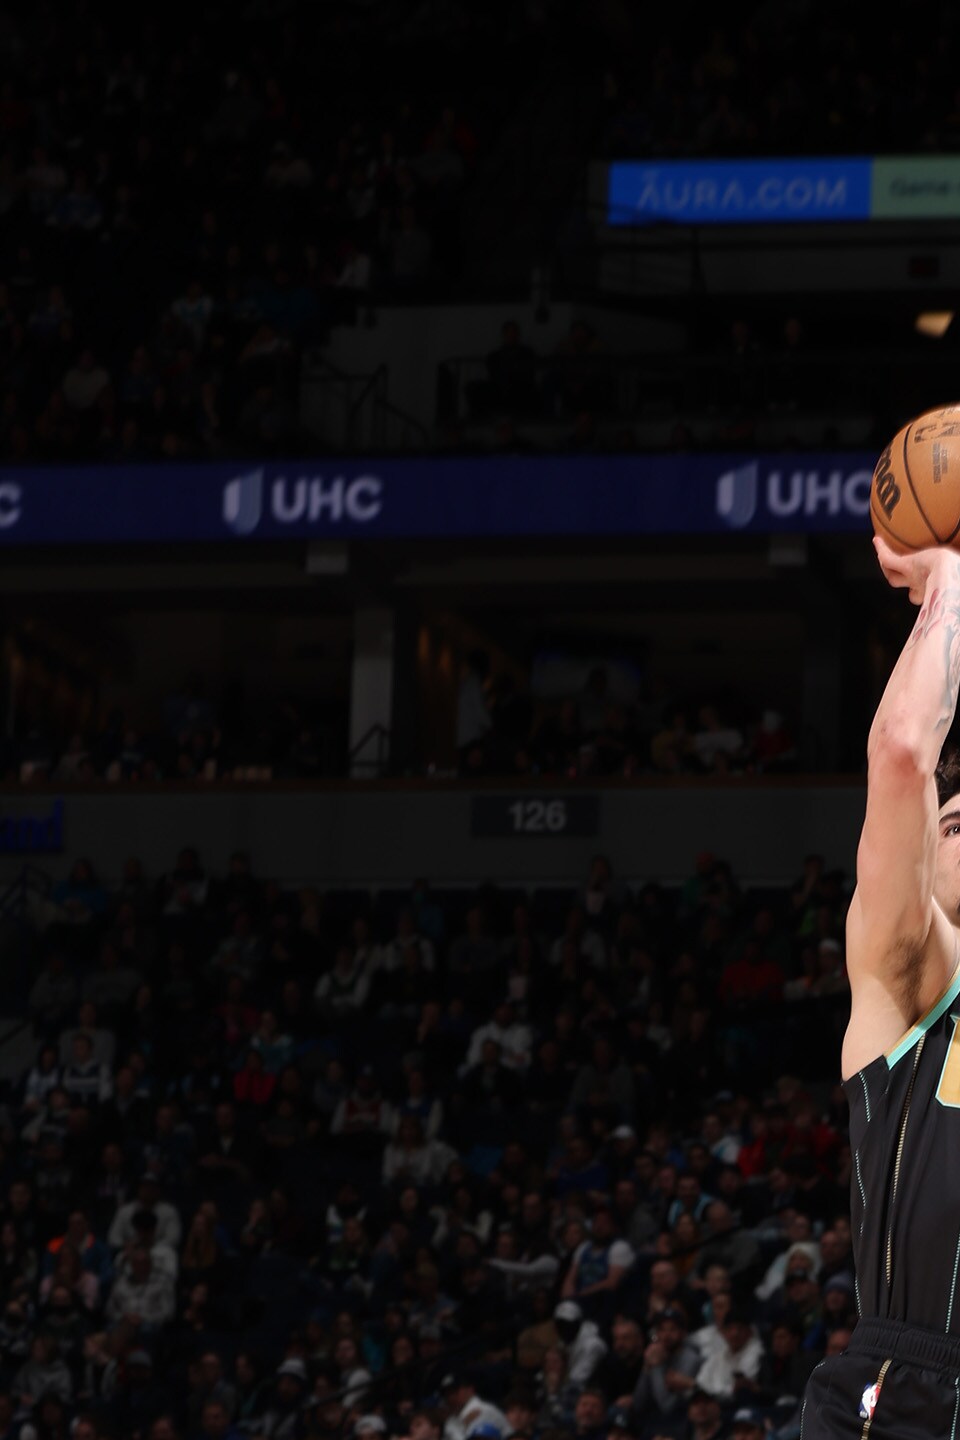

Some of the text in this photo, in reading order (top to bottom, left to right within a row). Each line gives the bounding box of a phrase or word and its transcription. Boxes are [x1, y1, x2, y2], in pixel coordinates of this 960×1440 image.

[271, 474, 383, 522] UHC
[766, 470, 873, 517] UHC
[508, 799, 568, 832] 126
